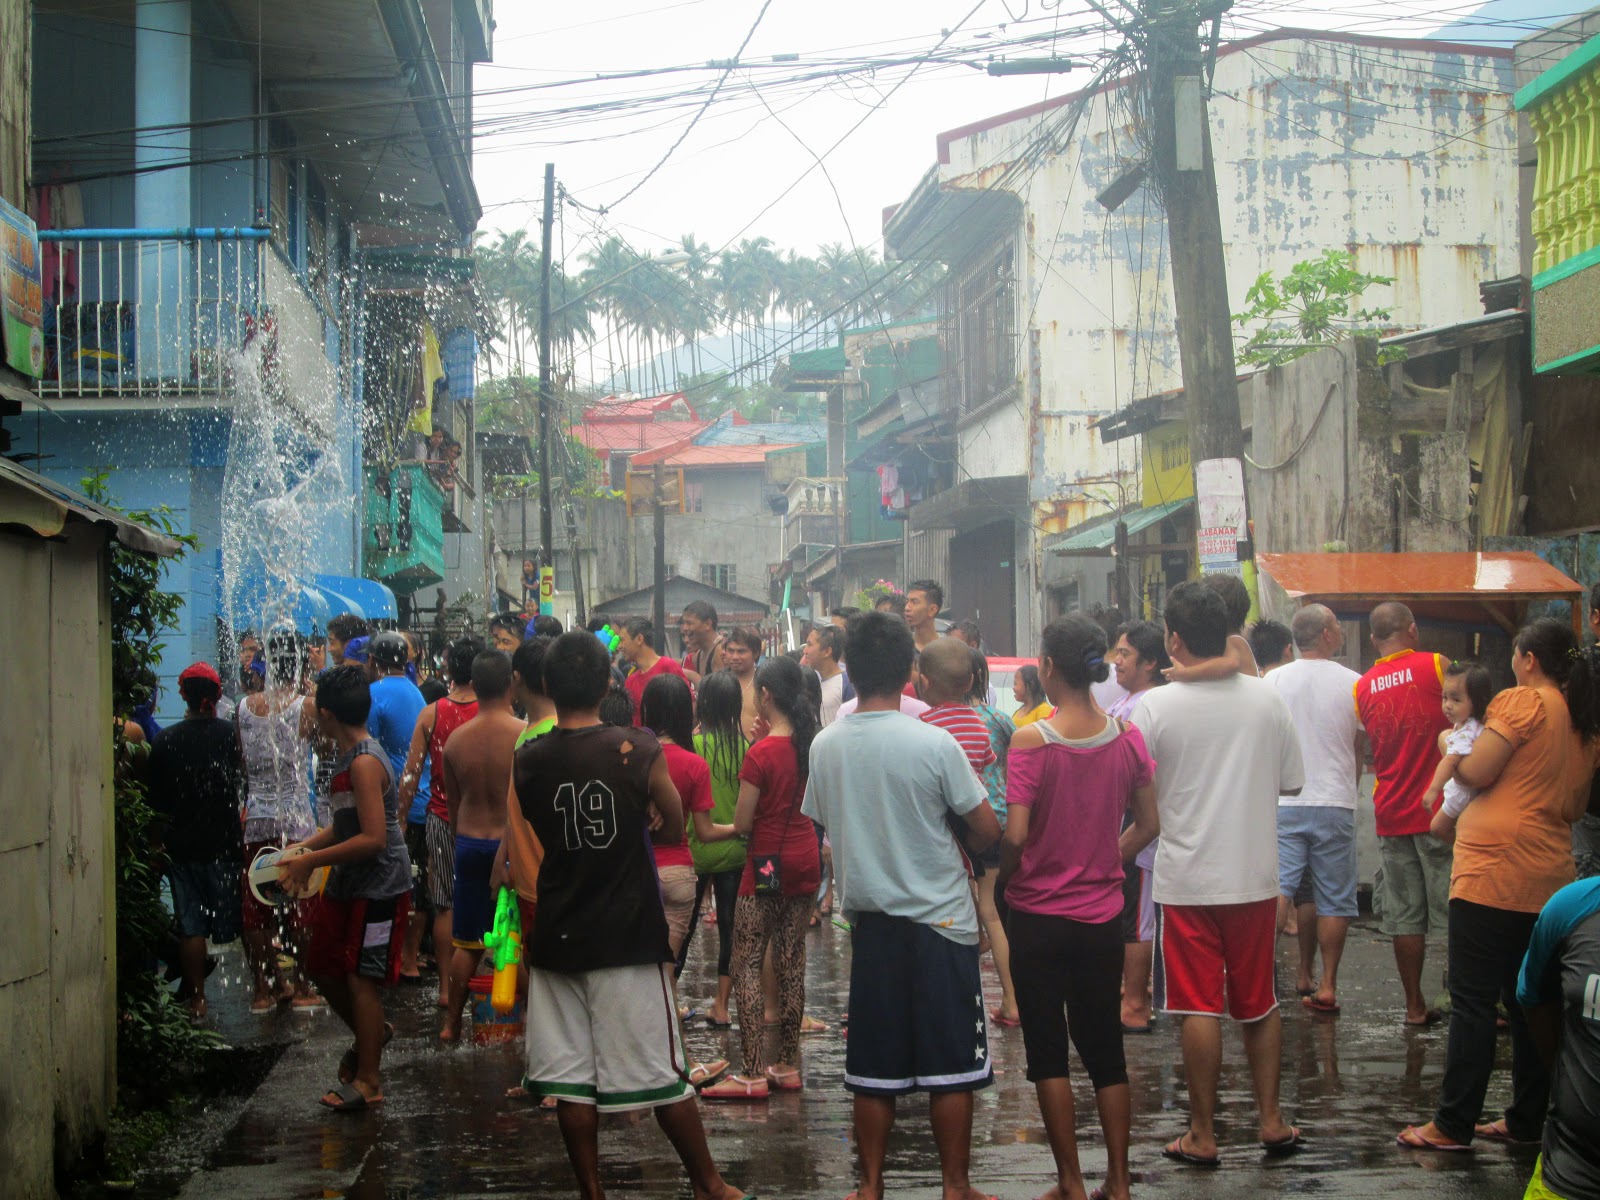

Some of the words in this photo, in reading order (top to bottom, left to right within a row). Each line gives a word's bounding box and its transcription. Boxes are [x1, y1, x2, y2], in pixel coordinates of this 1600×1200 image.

[540, 575, 553, 597] 5
[1370, 667, 1413, 695] ABUEVA
[553, 779, 618, 851] 19
